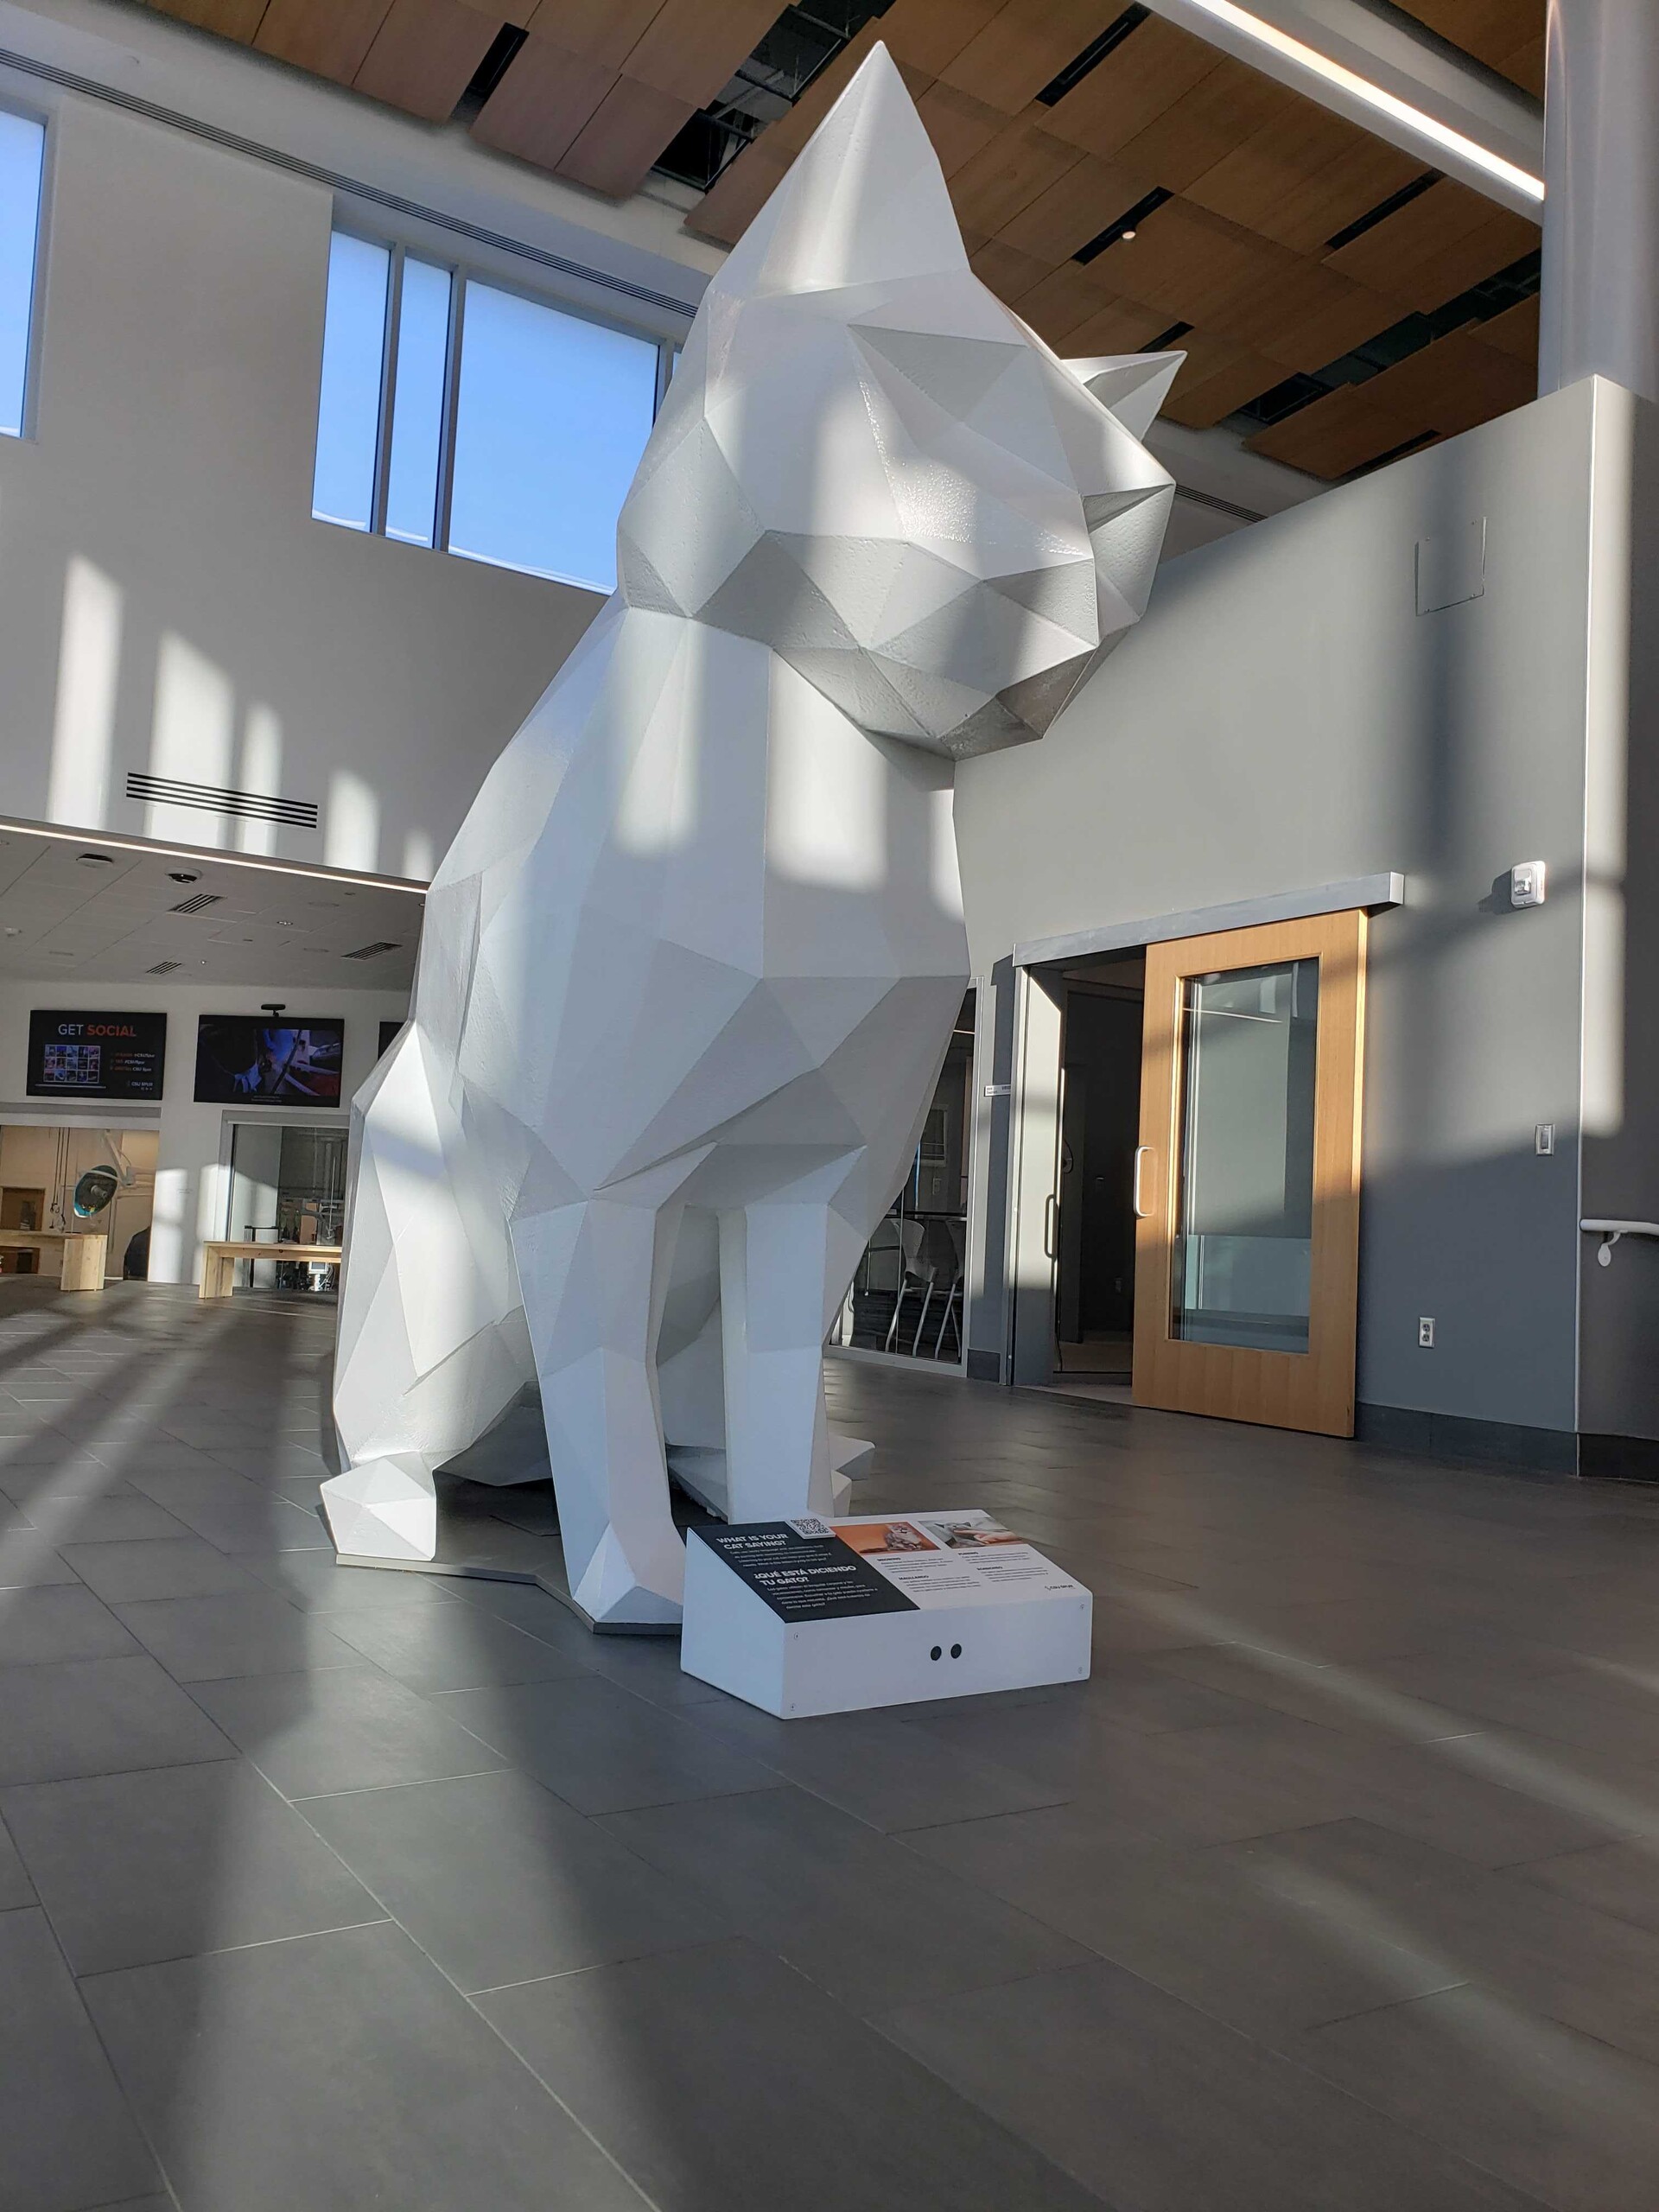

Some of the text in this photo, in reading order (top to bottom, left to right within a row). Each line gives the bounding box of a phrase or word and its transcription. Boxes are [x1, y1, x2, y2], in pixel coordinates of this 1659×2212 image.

[58, 1024, 137, 1037] GET SOCIAL
[745, 1540, 787, 1548] SAYING?
[753, 1565, 857, 1580] ¿QUÉ ESTÁ DICIENDO
[777, 1576, 810, 1585] GATO?
